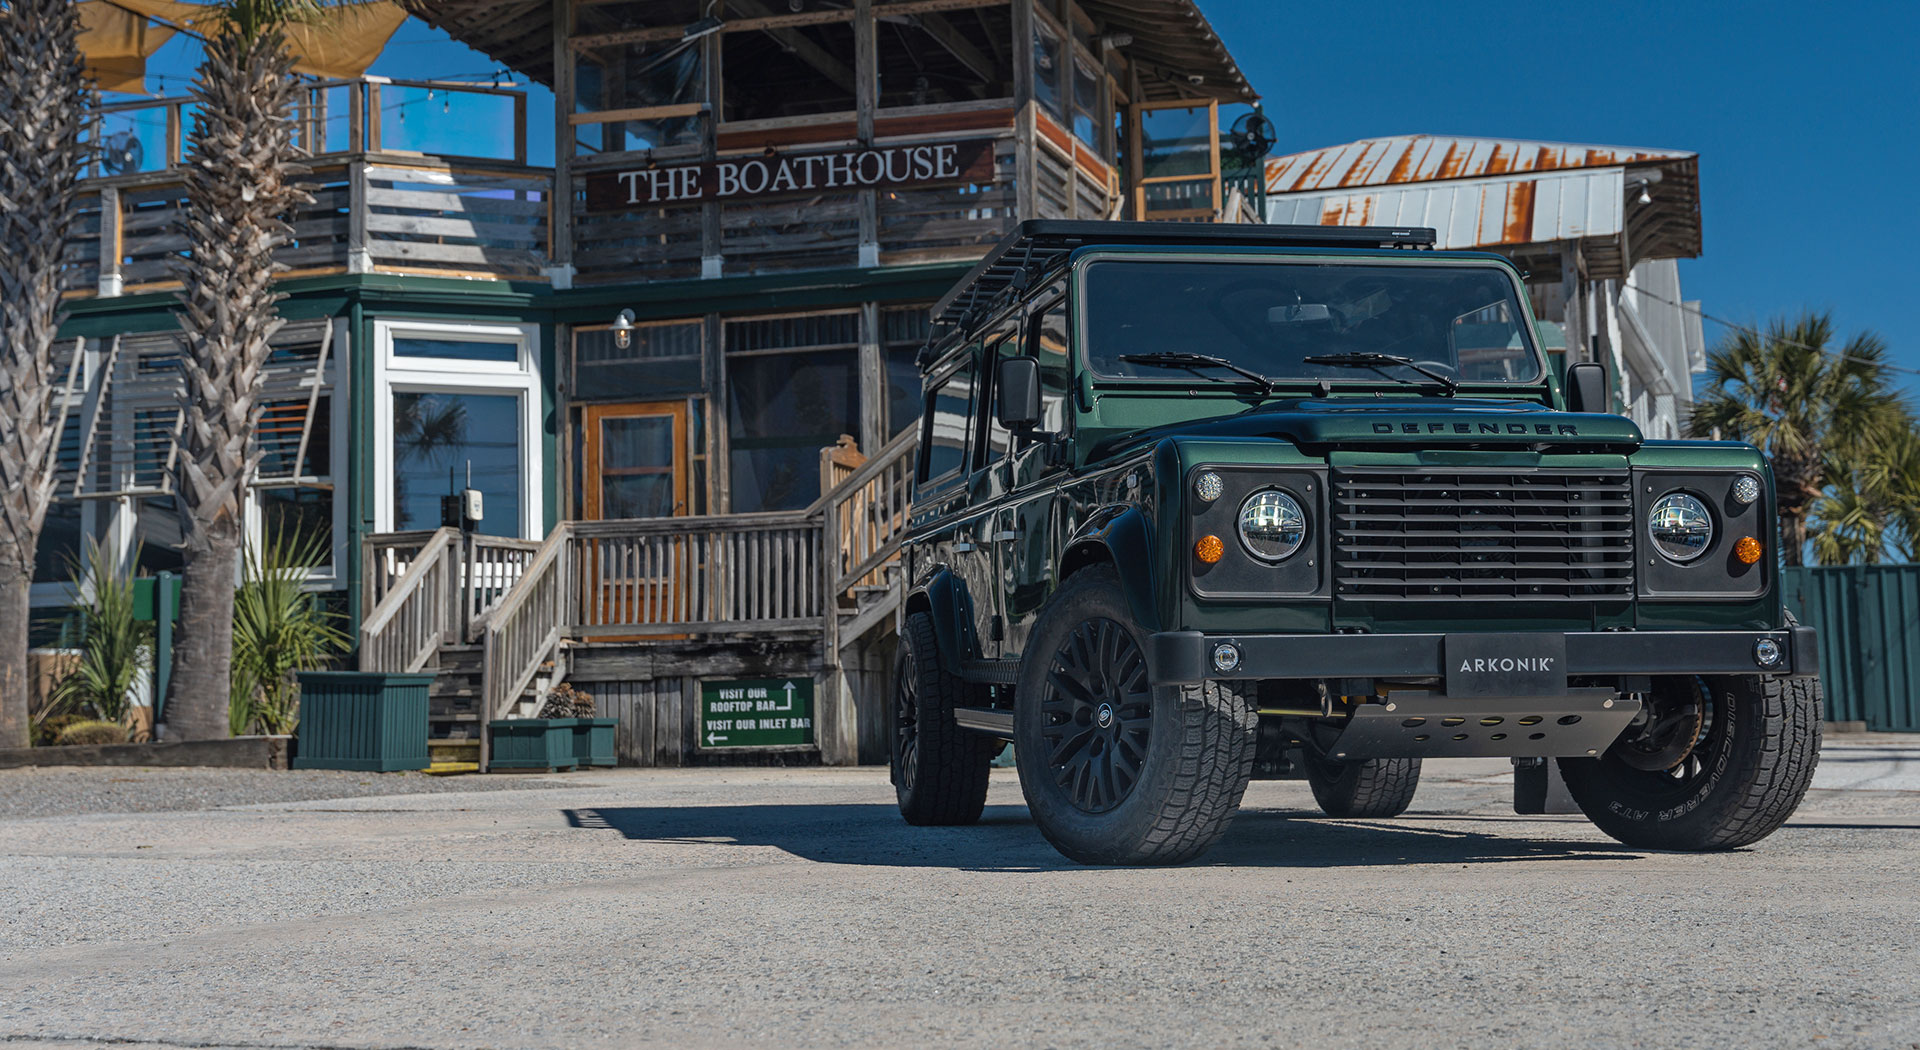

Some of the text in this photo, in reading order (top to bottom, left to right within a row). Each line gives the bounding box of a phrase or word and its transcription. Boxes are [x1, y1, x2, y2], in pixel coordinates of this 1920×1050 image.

[618, 143, 960, 204] THE BOATHOUSE
[1371, 422, 1579, 436] DEFENDER
[719, 687, 767, 699] VISIT OUR
[710, 700, 776, 713] ROOFTOP BAR
[706, 717, 811, 731] VISIT OUR INLET BAR
[1608, 692, 1737, 822] DISCOVERER AT3
